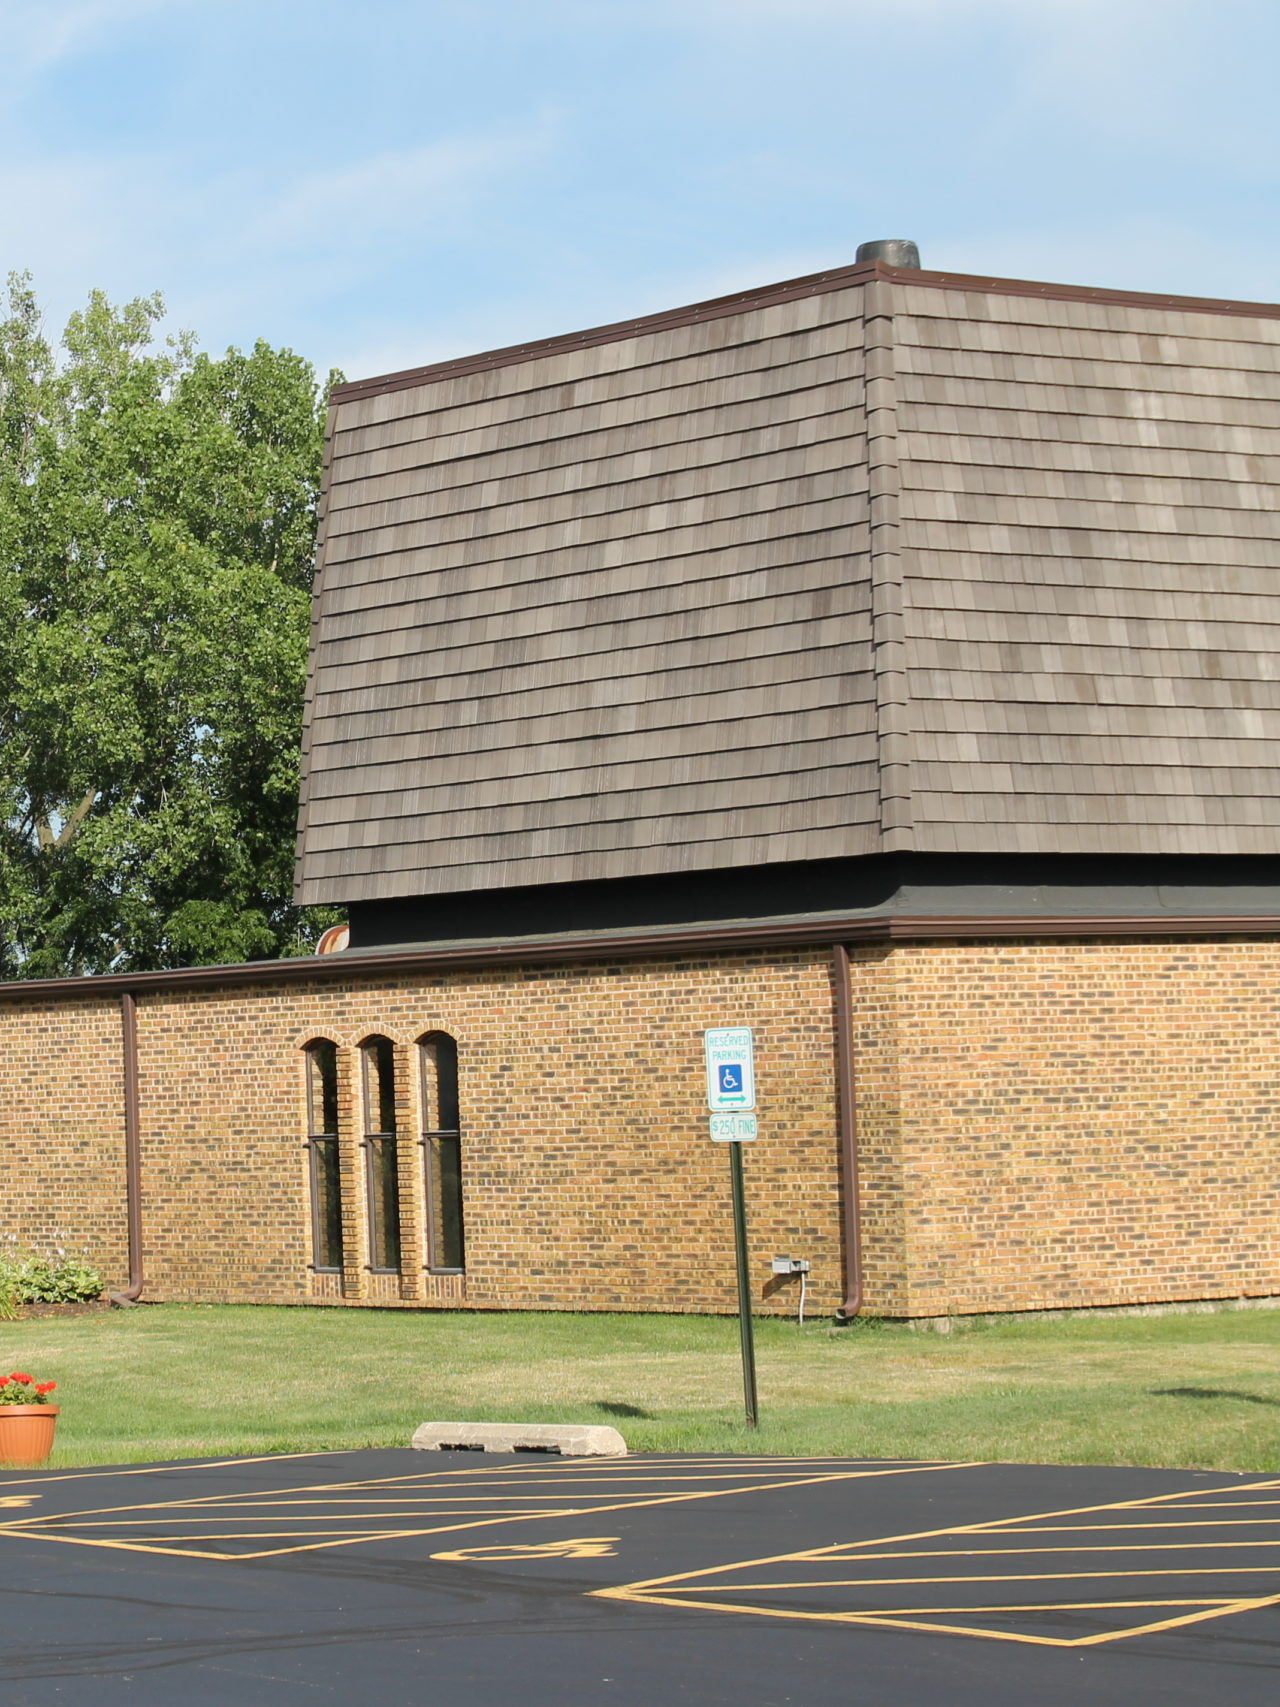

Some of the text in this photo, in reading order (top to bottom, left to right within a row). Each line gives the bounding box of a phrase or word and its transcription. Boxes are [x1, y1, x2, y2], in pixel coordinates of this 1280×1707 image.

[709, 1035, 749, 1047] RESERVED
[712, 1049, 747, 1060] PARKING
[712, 1119, 756, 1135] $250 FINE
